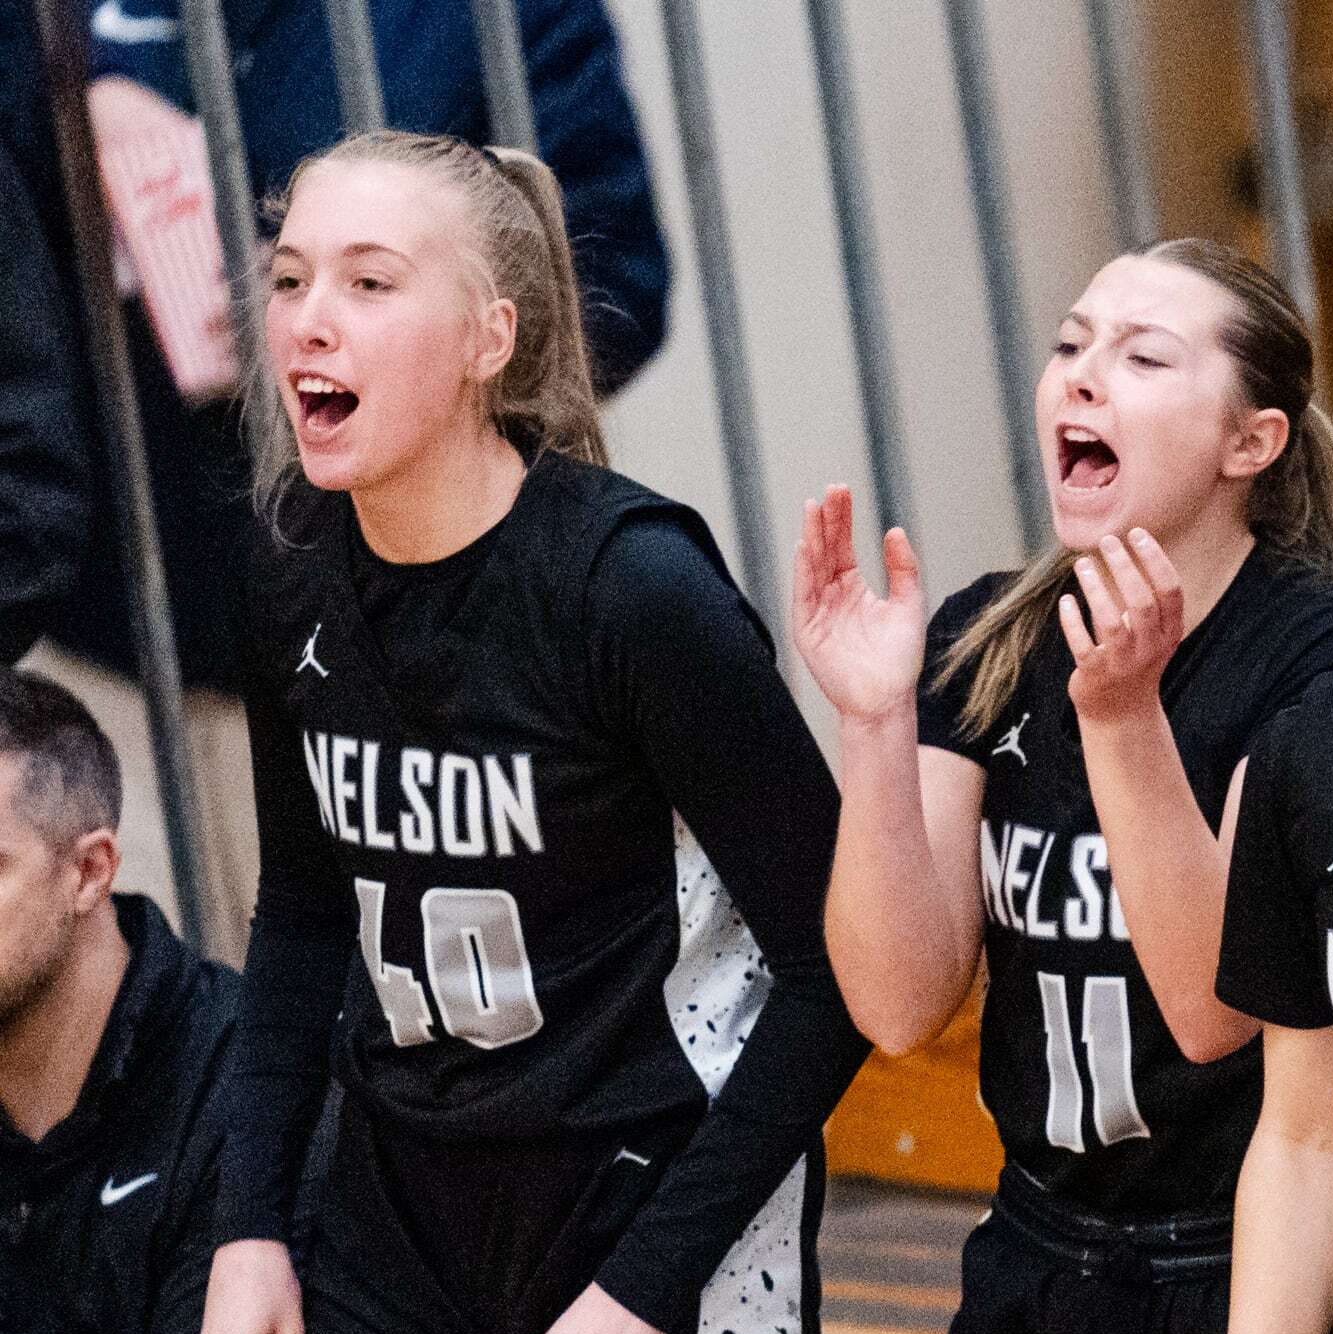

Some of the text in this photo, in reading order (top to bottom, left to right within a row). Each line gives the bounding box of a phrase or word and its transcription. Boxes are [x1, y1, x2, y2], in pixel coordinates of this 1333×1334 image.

[303, 730, 545, 857] NELSON
[979, 818, 1132, 942] NELS
[354, 876, 545, 1050] 40
[1037, 970, 1152, 1153] 11
